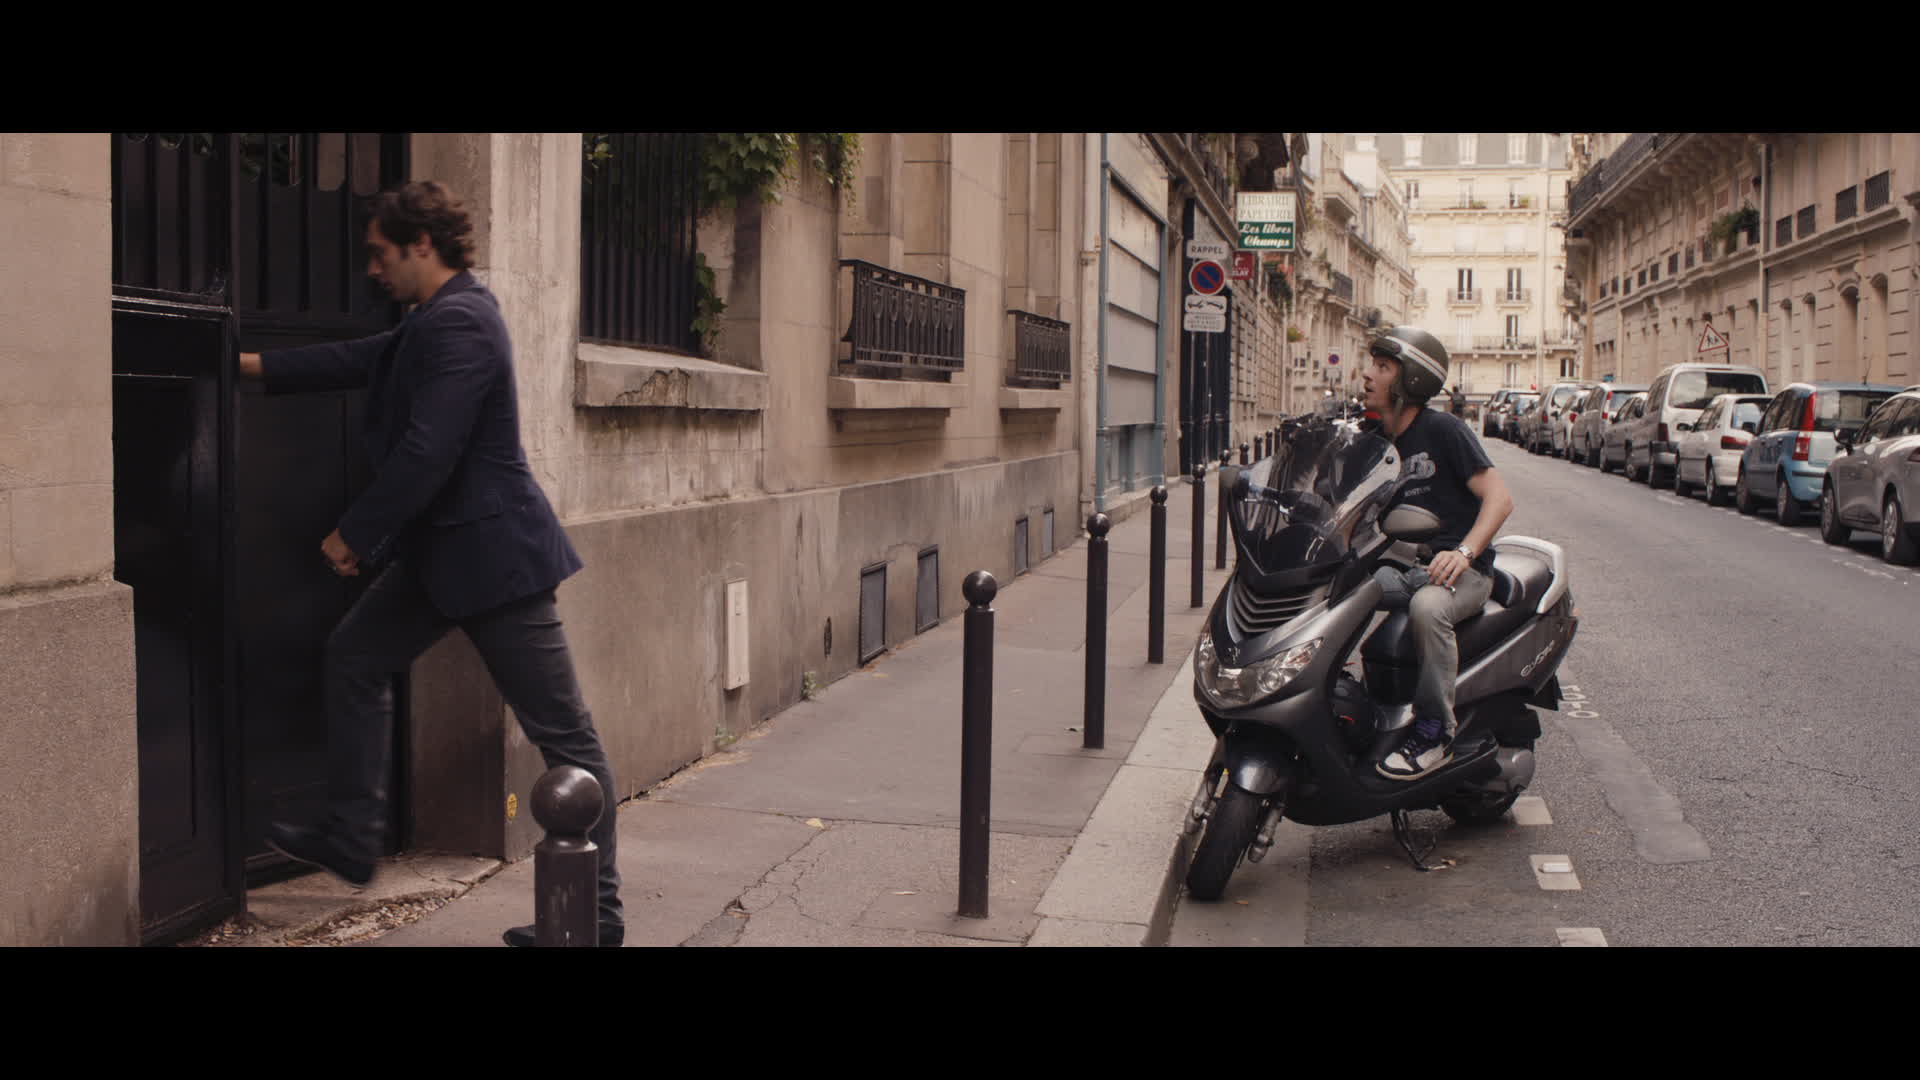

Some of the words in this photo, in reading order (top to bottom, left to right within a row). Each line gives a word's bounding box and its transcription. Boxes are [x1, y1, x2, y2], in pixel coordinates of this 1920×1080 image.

[1239, 223, 1260, 233] Les
[1262, 223, 1292, 234] libres
[1244, 235, 1290, 248] Champs
[1191, 245, 1224, 254] RAPPEL
